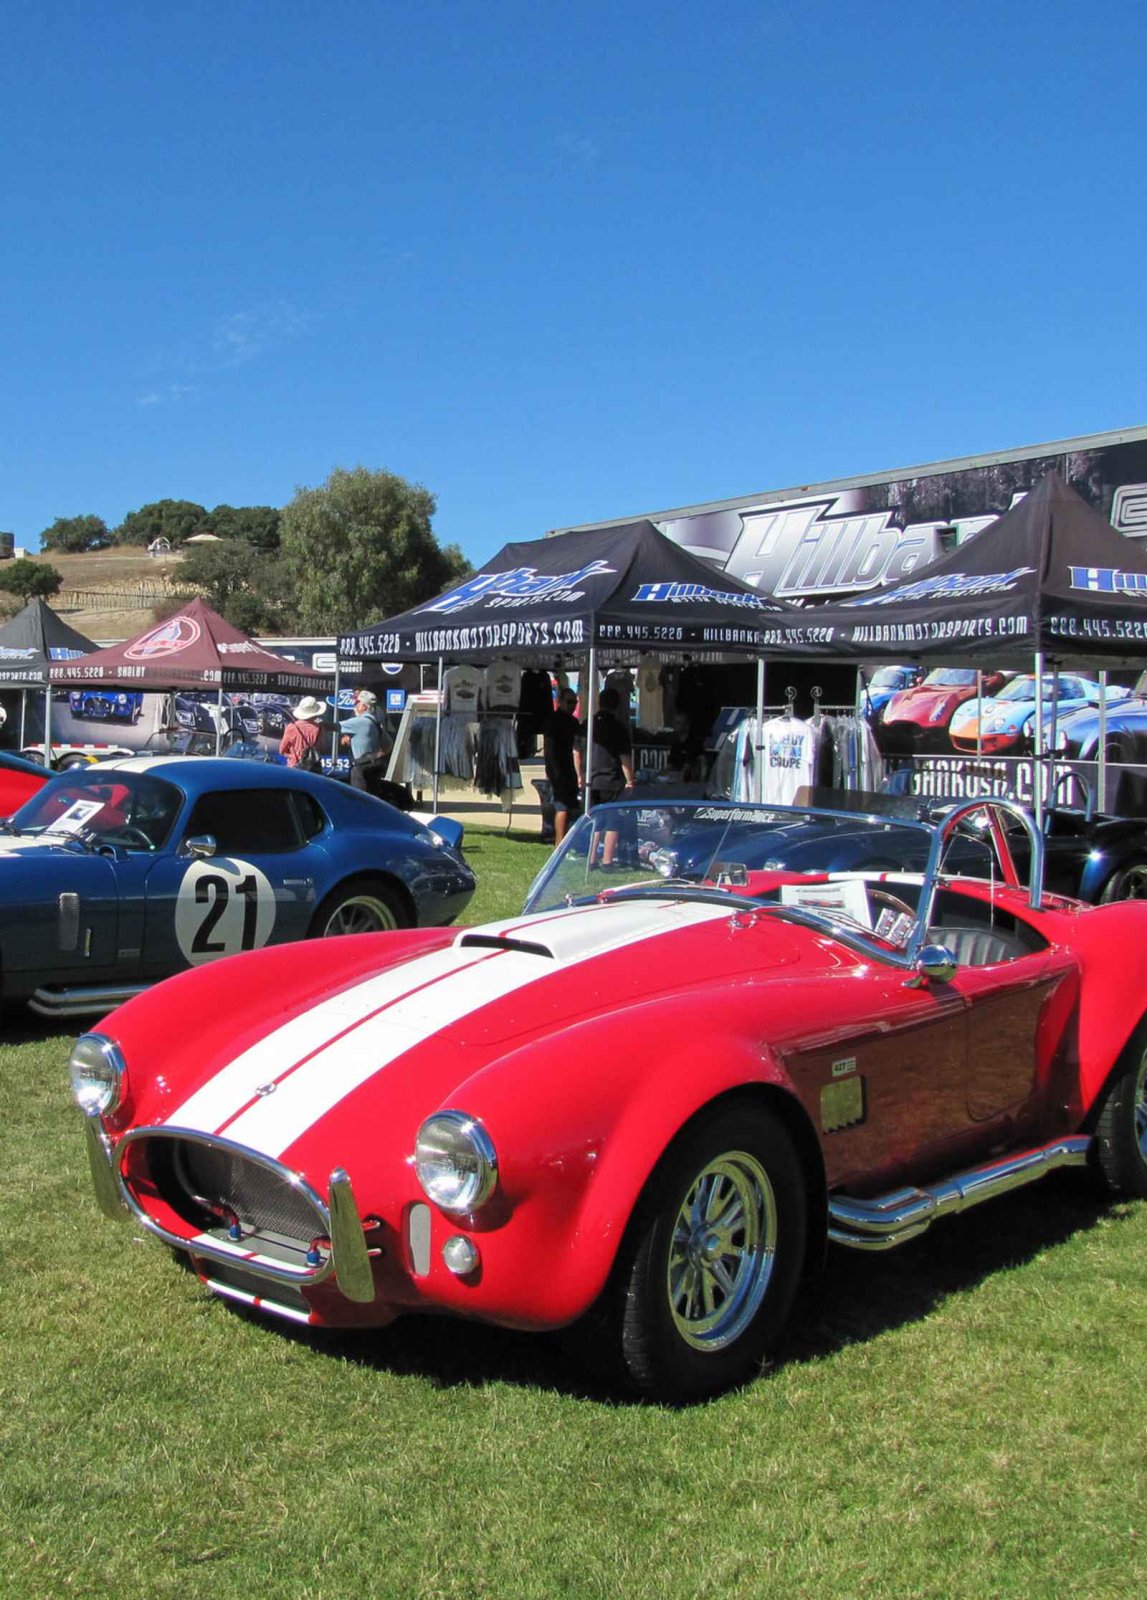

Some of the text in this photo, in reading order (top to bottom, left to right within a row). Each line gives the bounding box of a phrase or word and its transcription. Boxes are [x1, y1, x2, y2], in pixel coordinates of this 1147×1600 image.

[722, 493, 1000, 598] Hillba
[631, 581, 768, 608] Hillbank
[599, 625, 684, 640] 888.445.5226
[763, 627, 835, 645] 888.445.5226
[769, 756, 802, 769] COUPE
[191, 873, 259, 954] 21
